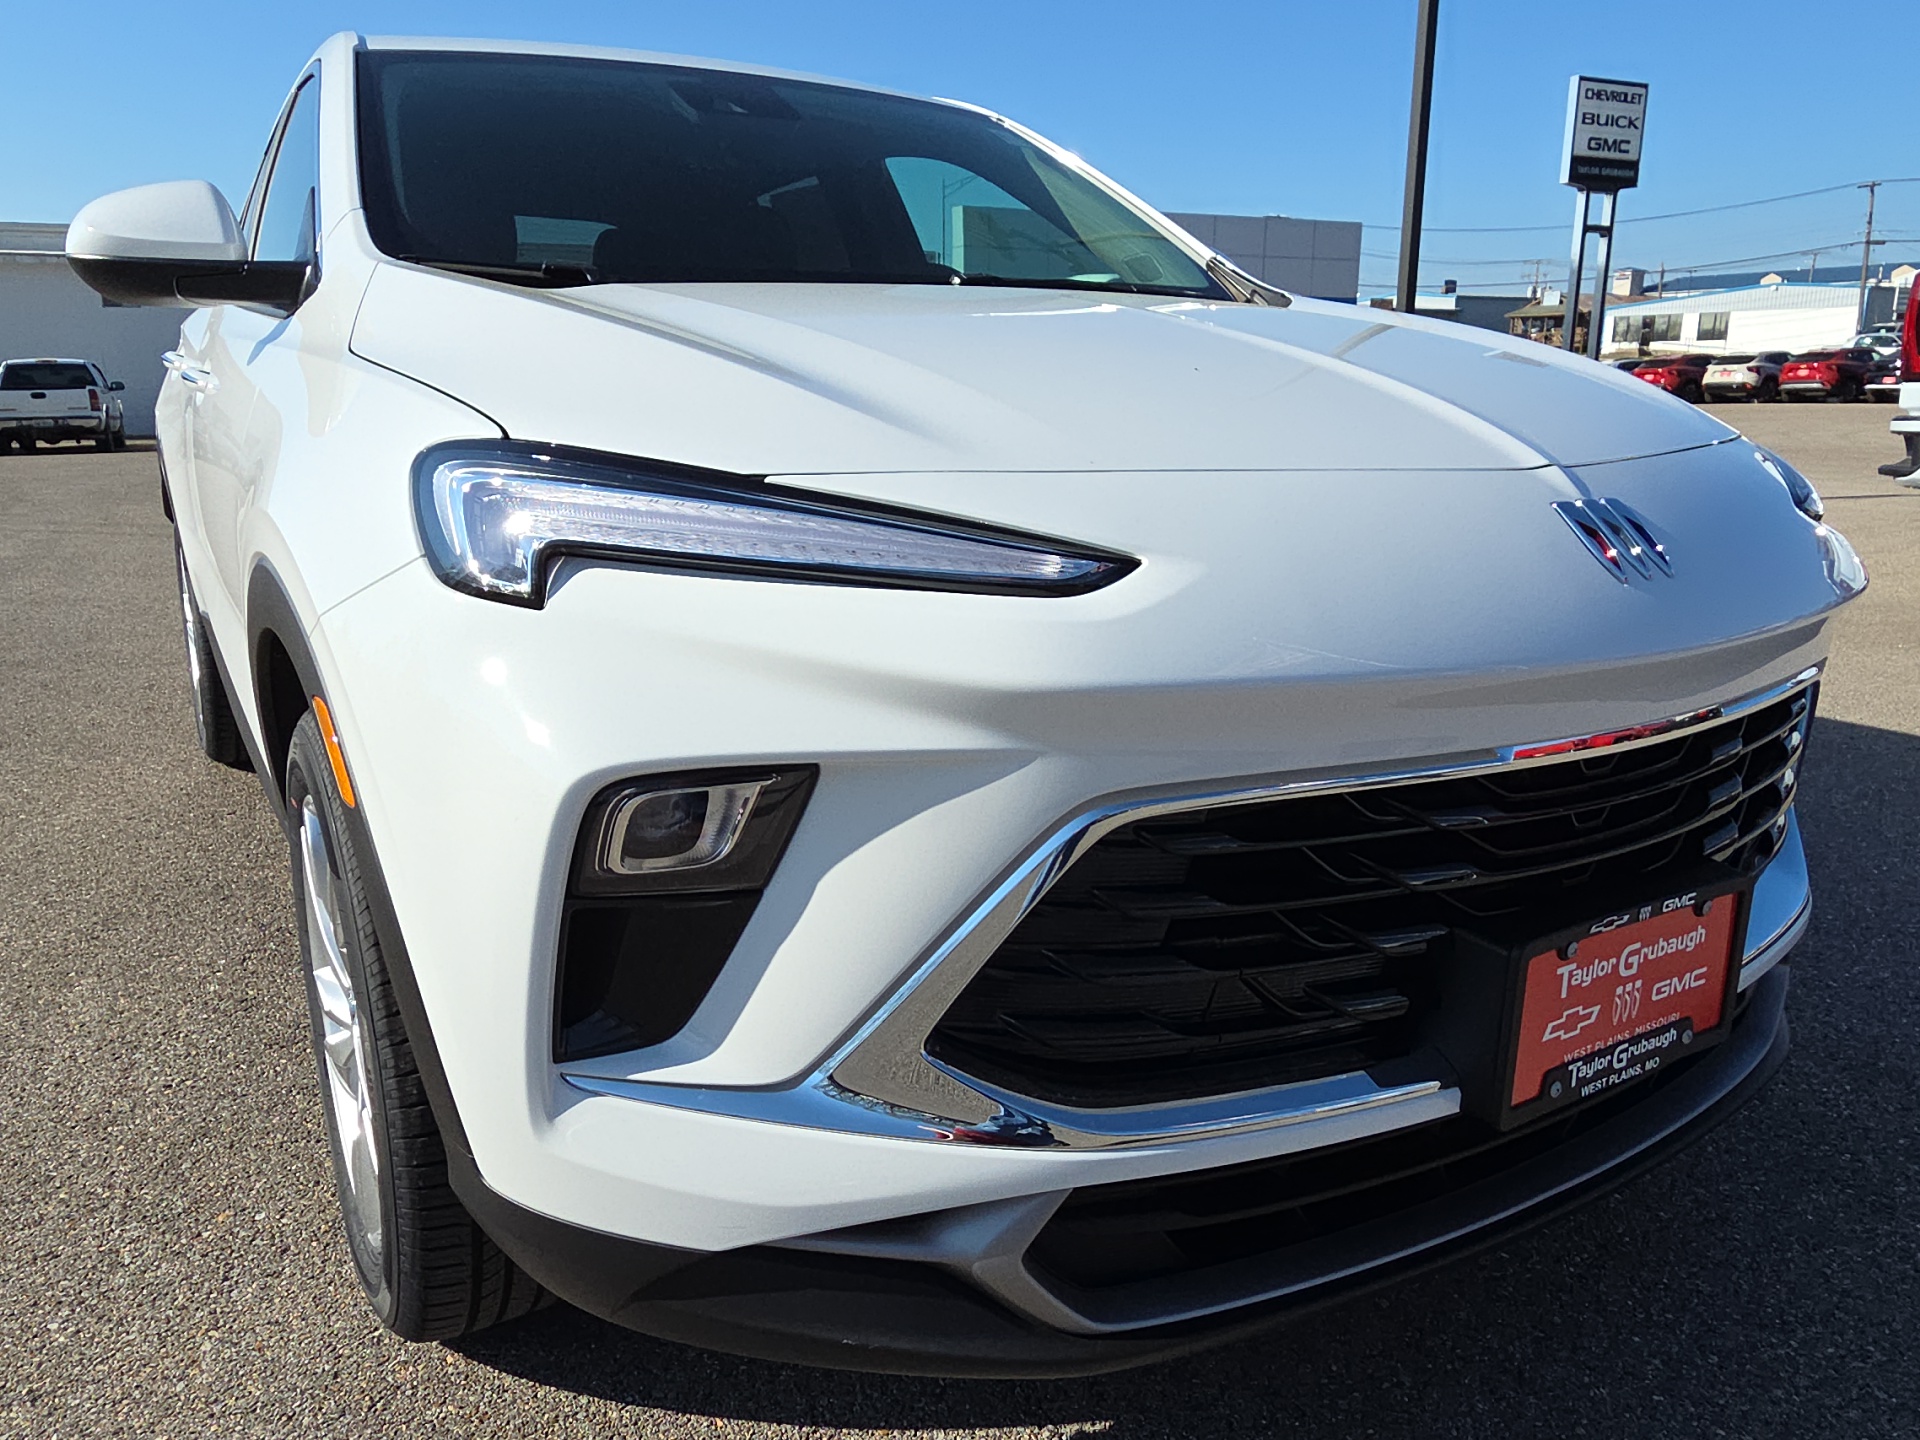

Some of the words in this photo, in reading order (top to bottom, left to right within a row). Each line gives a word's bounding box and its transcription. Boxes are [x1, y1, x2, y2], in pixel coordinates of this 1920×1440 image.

[1585, 88, 1643, 105] CHEVROLET
[1581, 112, 1639, 130] BUICK
[1587, 136, 1631, 154] GMC
[1662, 892, 1697, 913] GMC
[1557, 957, 1617, 999] Taylor
[1618, 925, 1706, 977] Grubaugh
[1651, 967, 1707, 1002] GMC
[1563, 1044, 1593, 1063] WEST
[1634, 1011, 1680, 1036] MISSOURI
[1568, 1055, 1611, 1088] Taylor
[1612, 1027, 1677, 1070] Grubaugh
[1580, 1078, 1608, 1098] WEST
[1608, 1063, 1643, 1088] PLAINS,
[1644, 1056, 1660, 1071] MO
